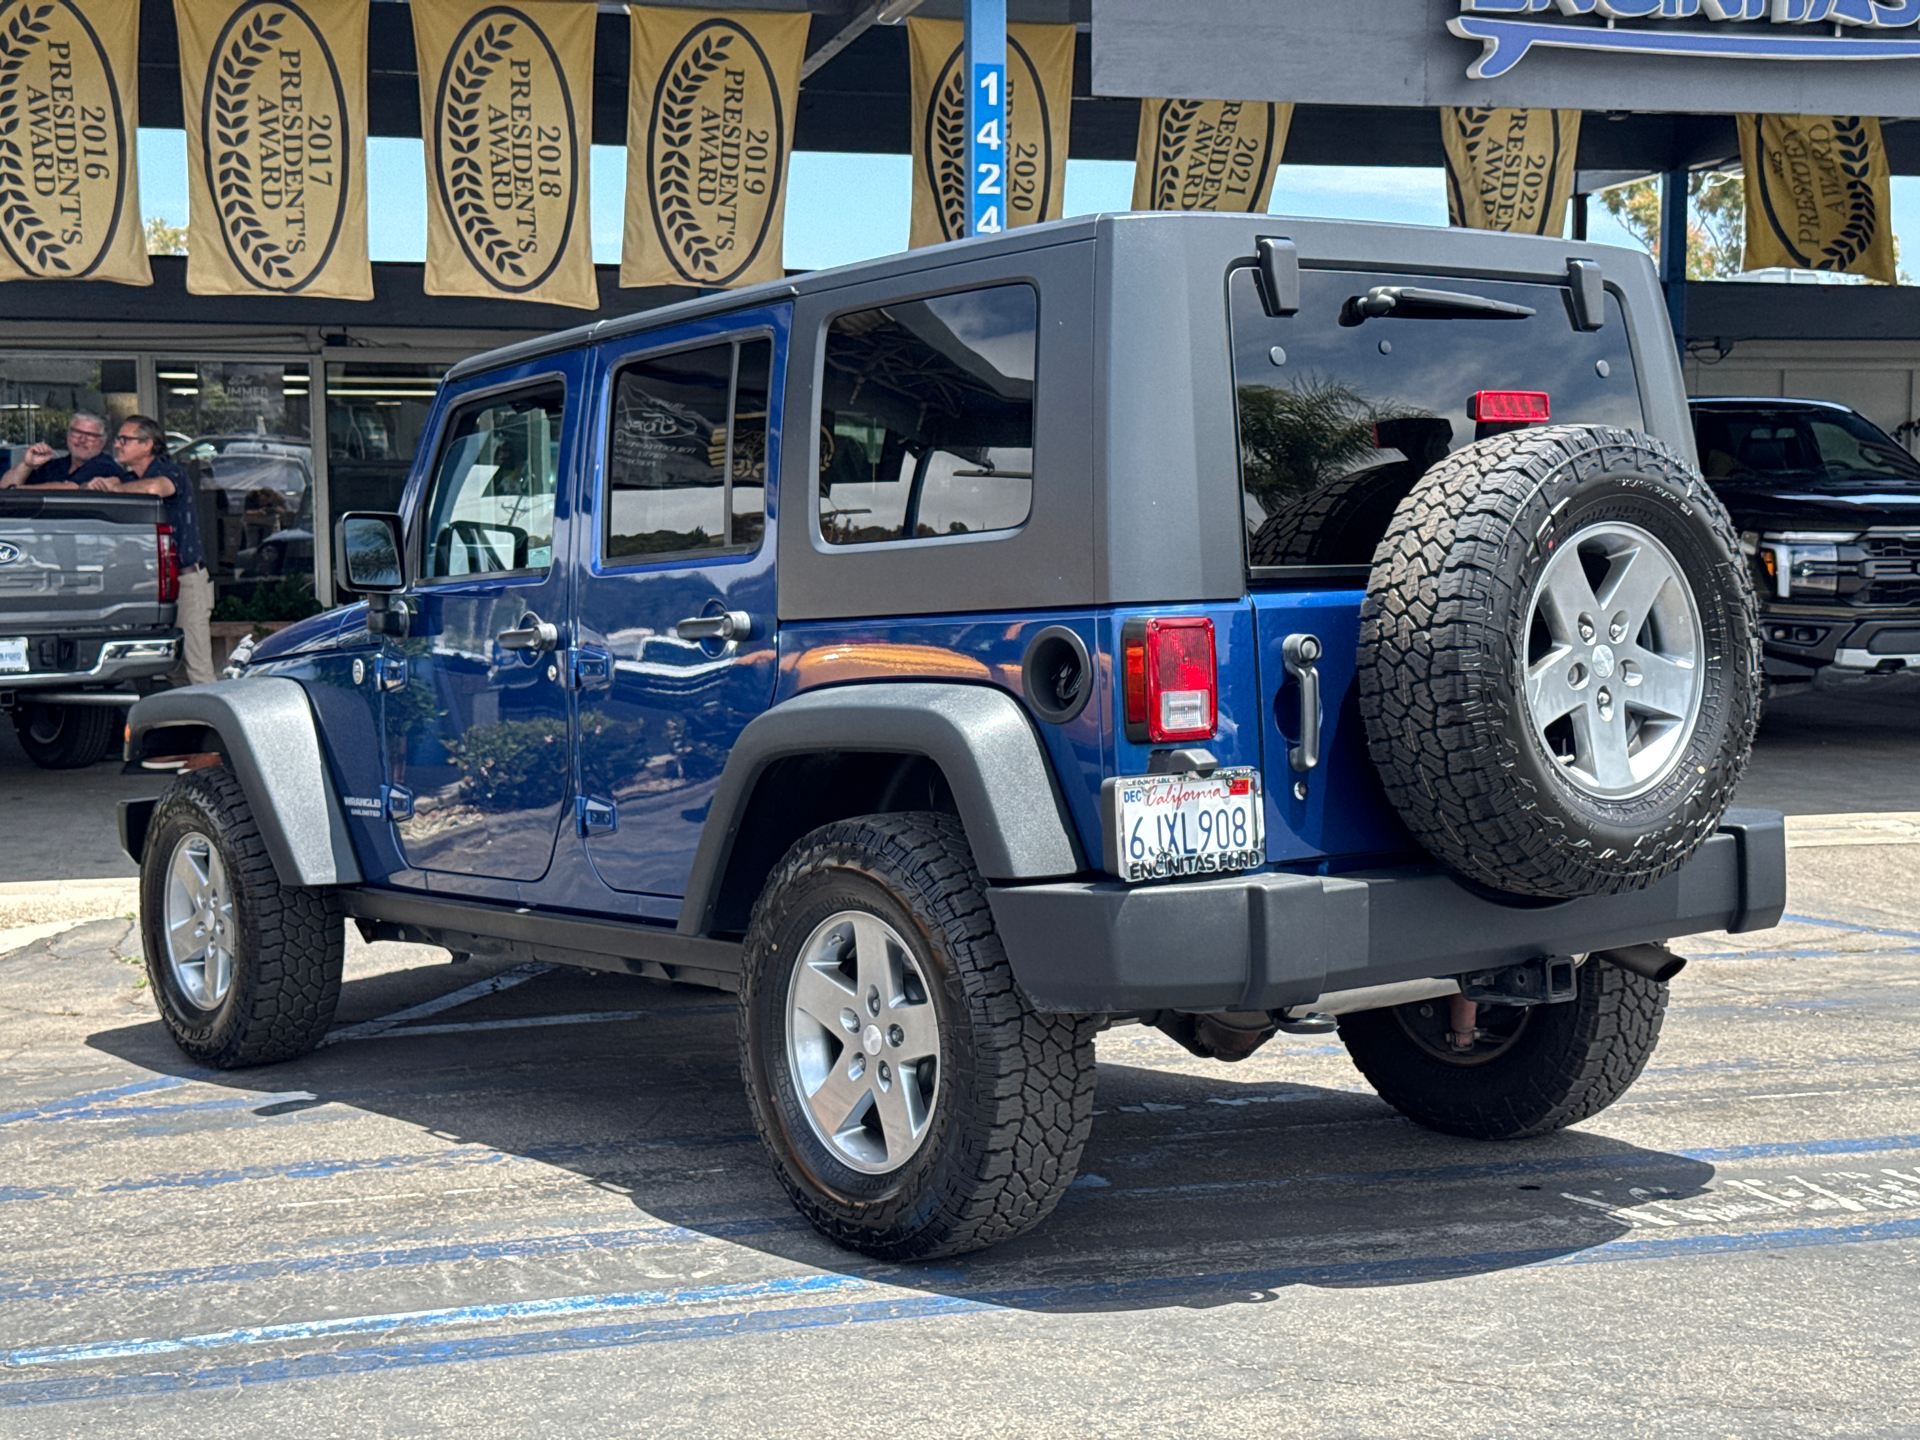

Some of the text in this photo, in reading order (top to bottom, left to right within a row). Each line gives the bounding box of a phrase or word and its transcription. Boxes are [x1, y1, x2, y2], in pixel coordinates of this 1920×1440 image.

[27, 84, 57, 197] AWARD
[48, 40, 84, 246] PRESIDENT'S
[80, 106, 110, 180] 2016
[257, 94, 284, 211] AWARD
[279, 48, 306, 254] PRESIDENT'S
[307, 114, 333, 188] 2017
[487, 103, 514, 211] AWARD
[510, 57, 538, 254] PRESIDENT'S
[537, 126, 563, 199] 2018
[697, 105, 720, 207] AWARD
[715, 67, 746, 251] PRESIDENT'S
[743, 130, 770, 196] 2019
[1011, 143, 1038, 212] 2020
[1181, 119, 1215, 211] AWARD
[1198, 101, 1243, 211] RESIDEN
[1225, 136, 1259, 195] 2021
[1516, 155, 1546, 221] 2022
[1123, 788, 1142, 803] DEC
[1146, 783, 1231, 811] California
[1129, 849, 1260, 880] ENCINITAS FORD
[1130, 806, 1247, 860] 6JXL908
